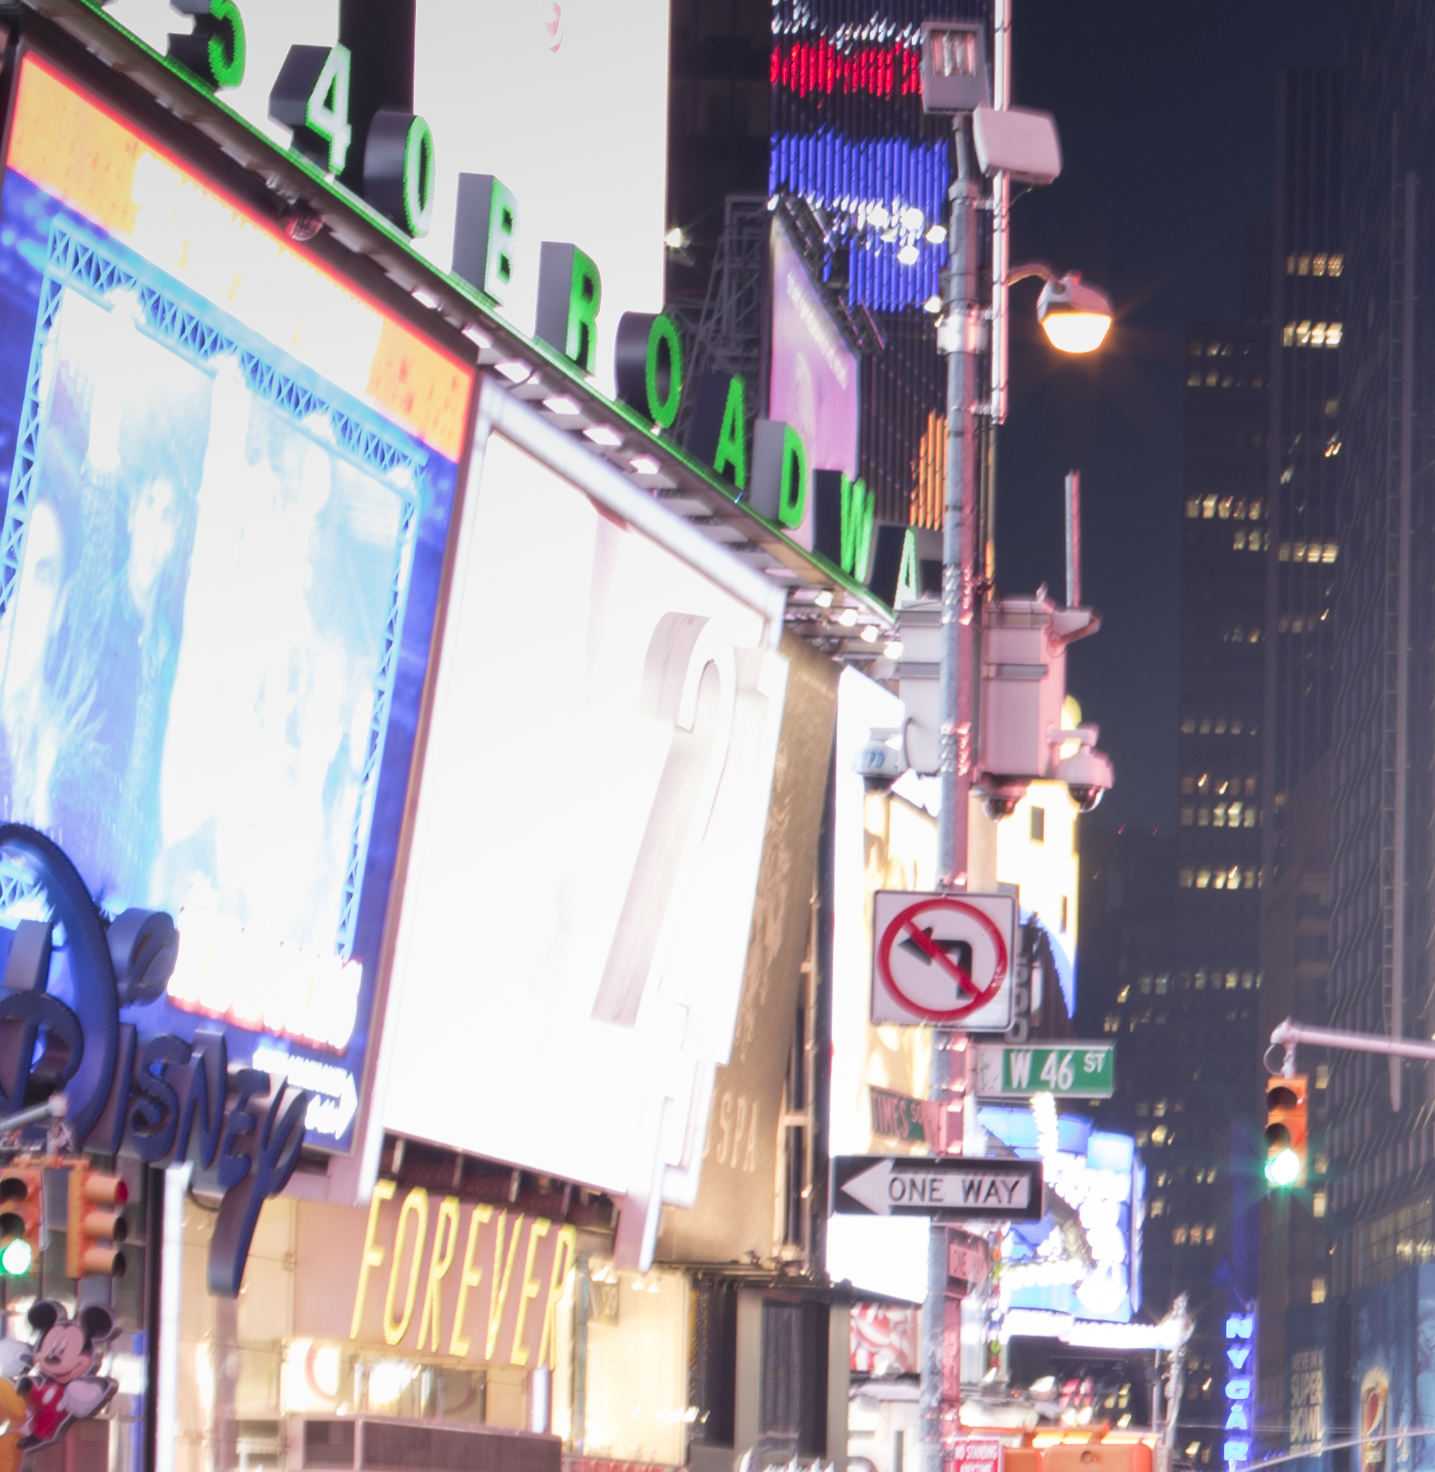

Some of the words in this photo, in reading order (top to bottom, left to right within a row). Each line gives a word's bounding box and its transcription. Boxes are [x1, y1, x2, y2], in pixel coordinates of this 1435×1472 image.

[485, 175, 922, 607] BROADWA
[1008, 1051, 1033, 1090] W
[1040, 1051, 1074, 1091] 46
[1083, 1053, 1106, 1073] ST
[871, 1090, 909, 1141] TIMES
[887, 1177, 945, 1203] ONE
[960, 1177, 1021, 1205] WAY
[350, 1179, 576, 1371] FOREVER
